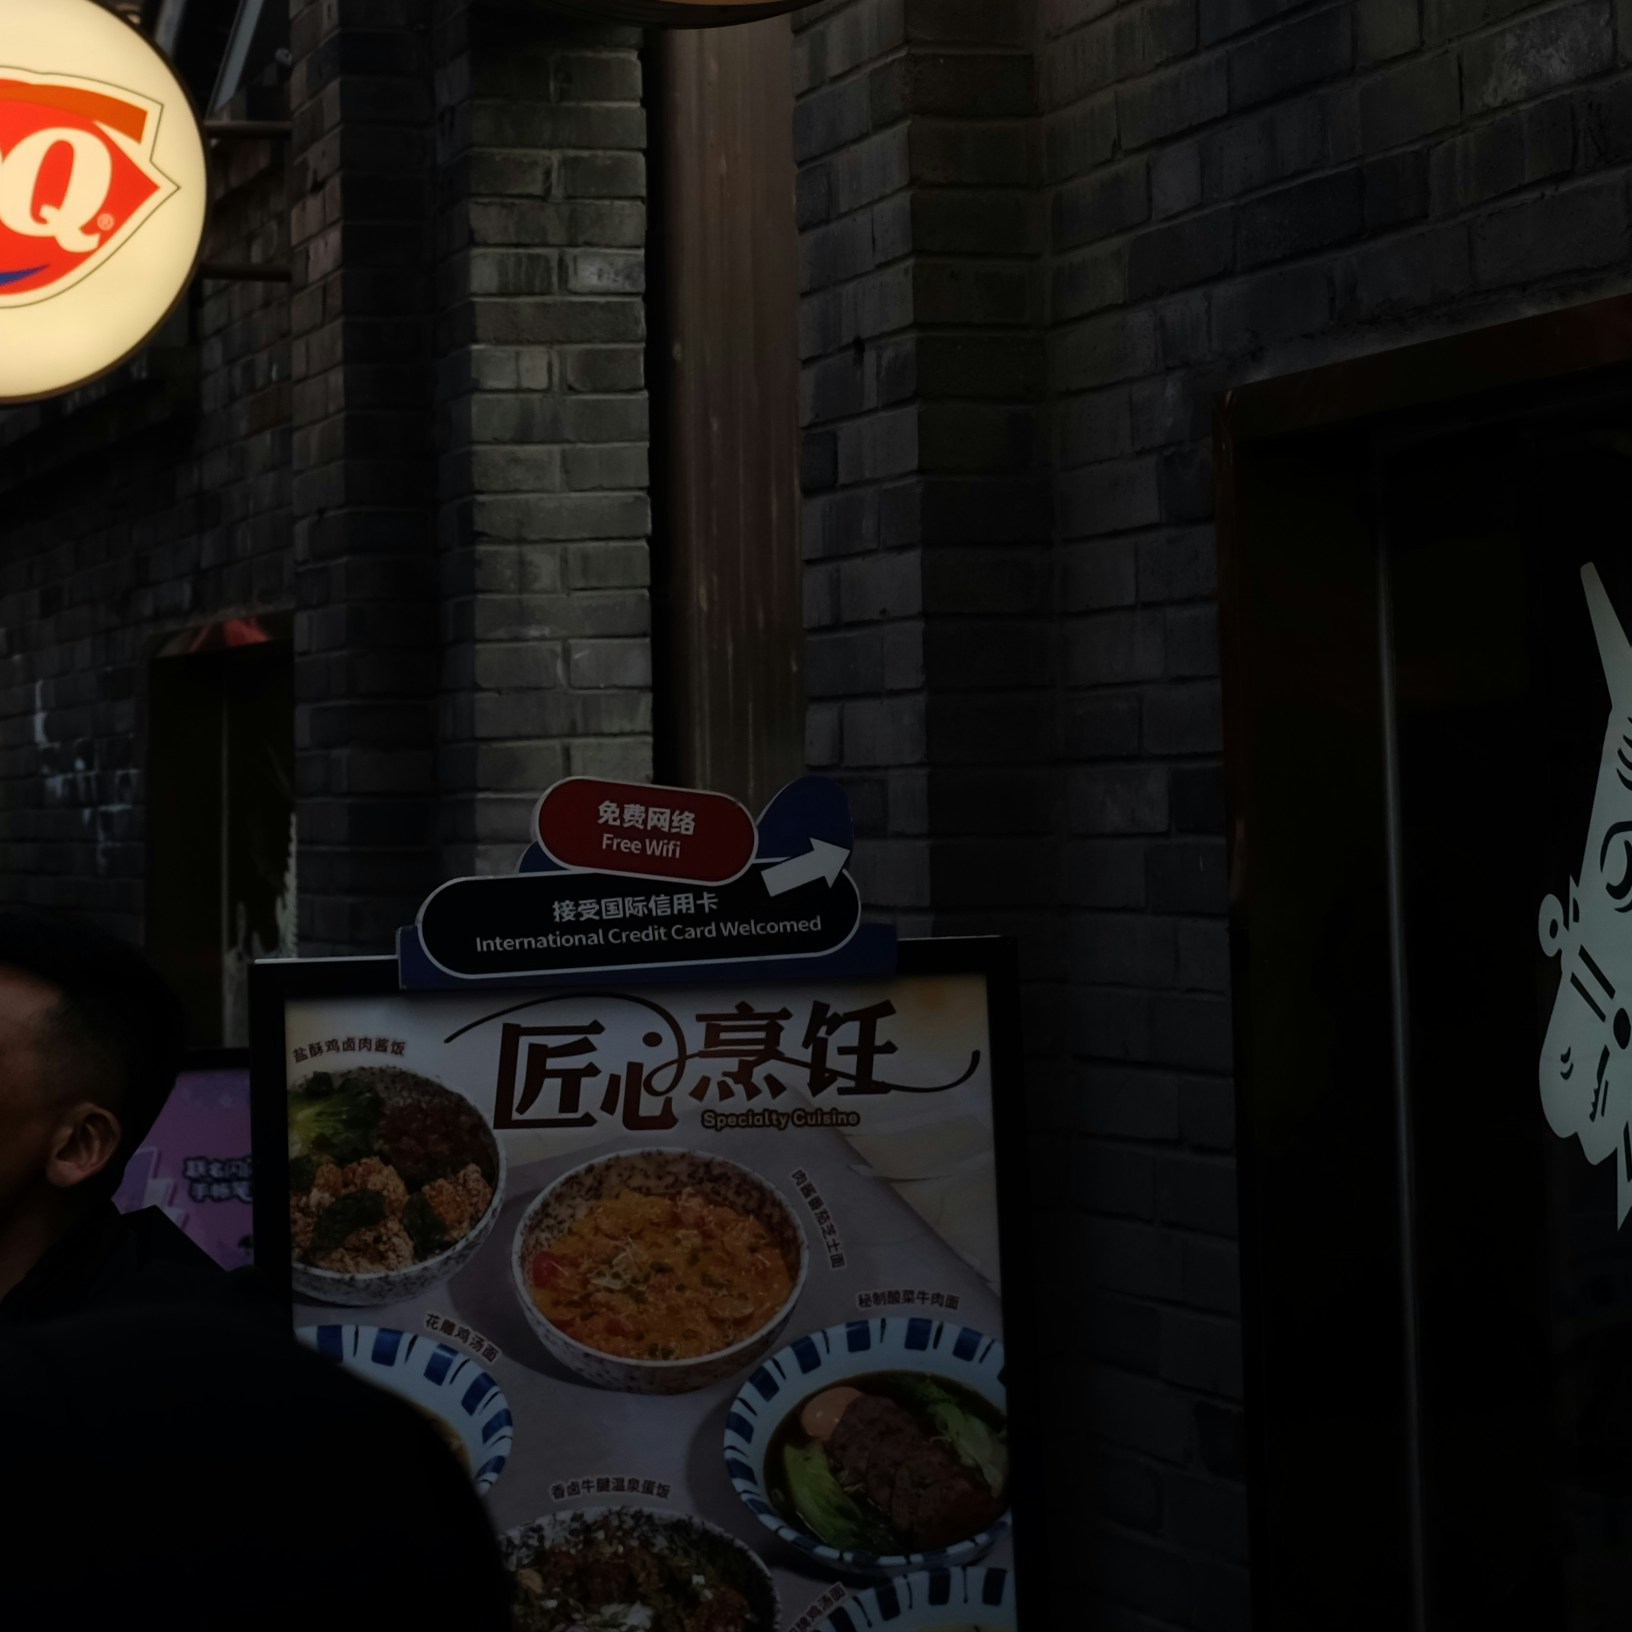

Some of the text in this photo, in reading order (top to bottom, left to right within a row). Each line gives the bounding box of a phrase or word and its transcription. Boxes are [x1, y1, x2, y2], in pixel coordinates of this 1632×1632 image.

[598, 800, 696, 836] 免费网络
[602, 833, 682, 859] Free Wifi
[552, 891, 719, 924] 接受国际信用卡
[476, 914, 822, 953] International Credit Card Welcomed
[292, 1037, 408, 1063] 盐酥鸡卤肉酱饭
[493, 999, 896, 1130] 匠心烹饪
[702, 1108, 860, 1130] Specialty Cuisine
[791, 1169, 846, 1268] 肉酱番茄芝士面
[425, 1312, 500, 1363] 花雕鸡汤面
